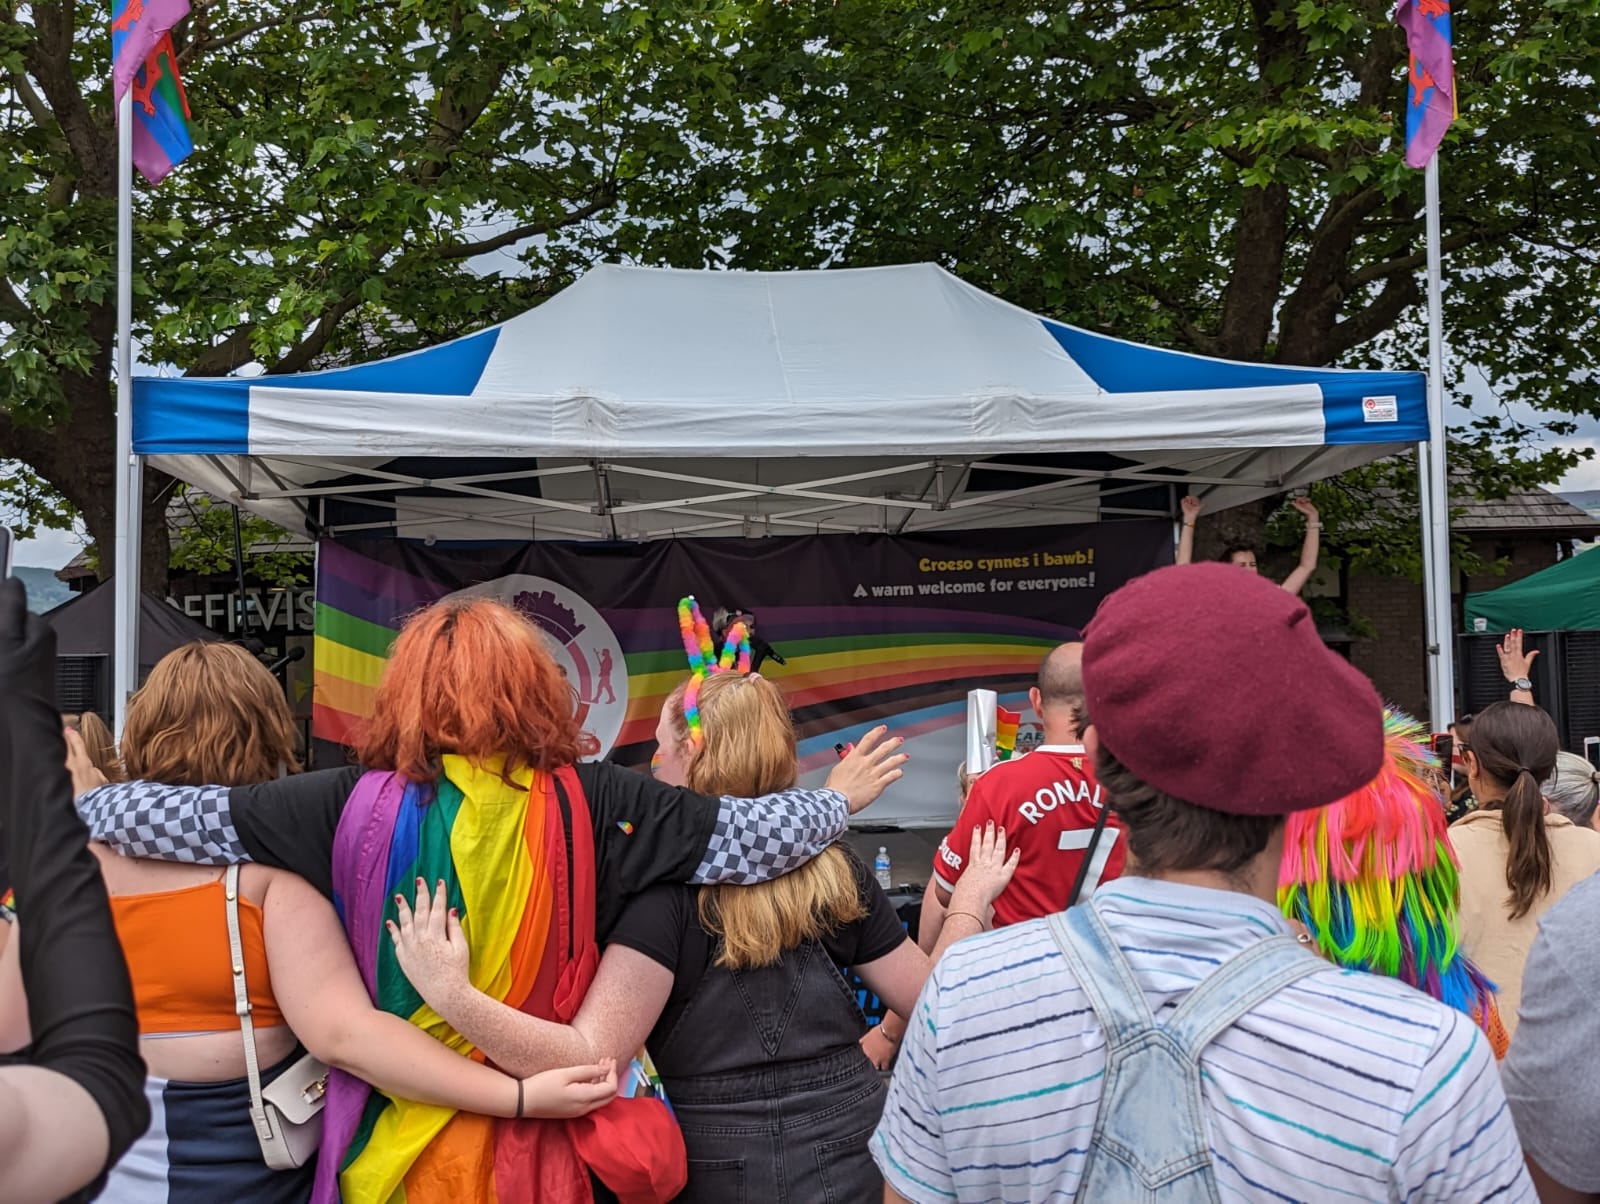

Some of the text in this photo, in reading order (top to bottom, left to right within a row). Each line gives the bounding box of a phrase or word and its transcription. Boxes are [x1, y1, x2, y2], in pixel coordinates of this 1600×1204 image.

[919, 549, 1095, 572] Croeso cynnes i bawb!
[853, 572, 1096, 598] A warm welcome for everyone!
[1018, 779, 1106, 825] RONAL
[1057, 827, 1121, 905] 7
